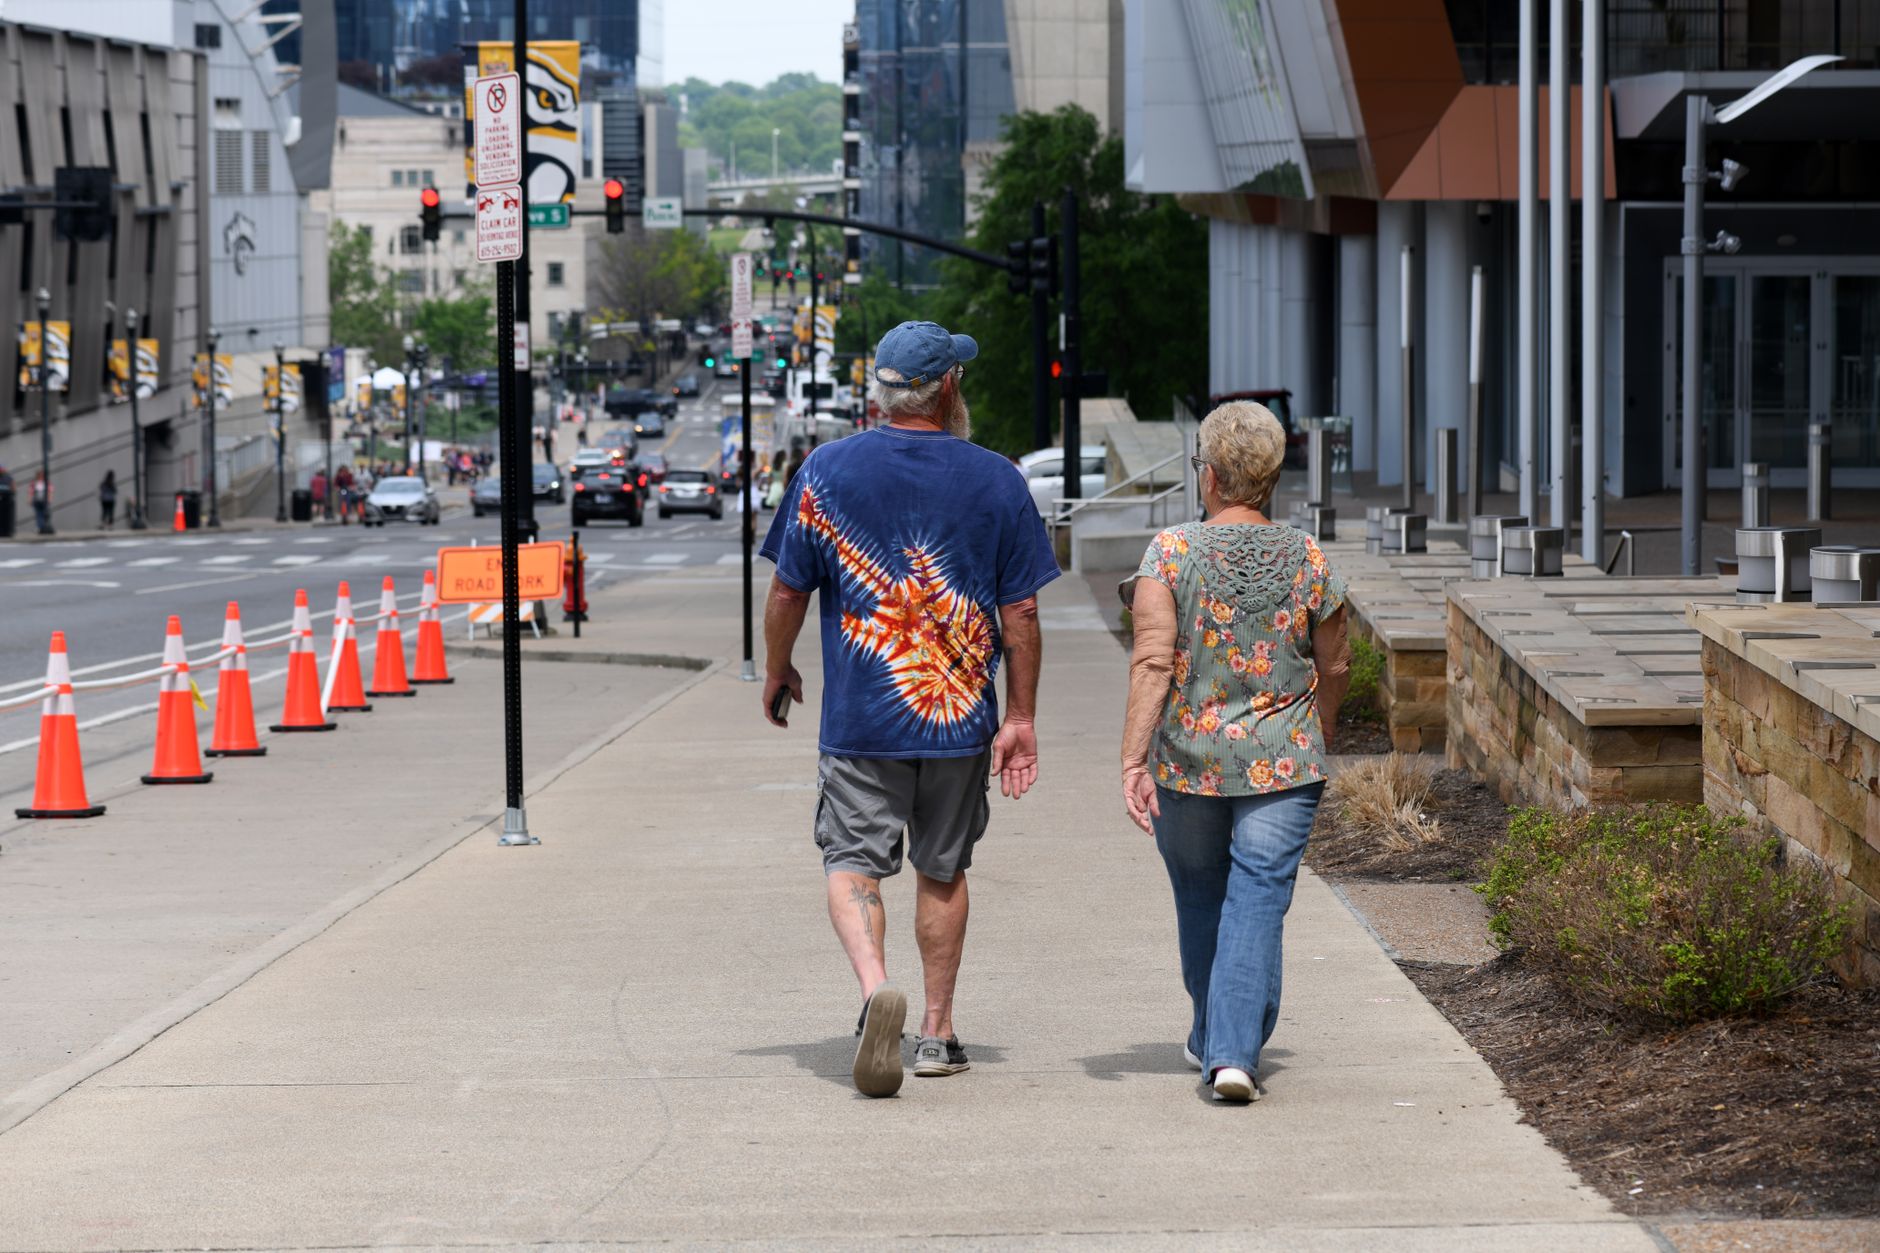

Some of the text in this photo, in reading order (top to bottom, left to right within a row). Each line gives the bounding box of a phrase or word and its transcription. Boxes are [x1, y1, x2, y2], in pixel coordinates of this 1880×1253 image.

[485, 125, 509, 133] PARKING
[485, 135, 509, 143] LOADING
[482, 142, 513, 152] UNLOADING
[485, 151, 510, 160] VENDING
[480, 160, 516, 170] SOLICITATION
[529, 209, 561, 222] ve S
[481, 216, 516, 230] CLAIM CAR
[486, 558, 503, 571] EN
[455, 575, 545, 592] ROAD ORK
